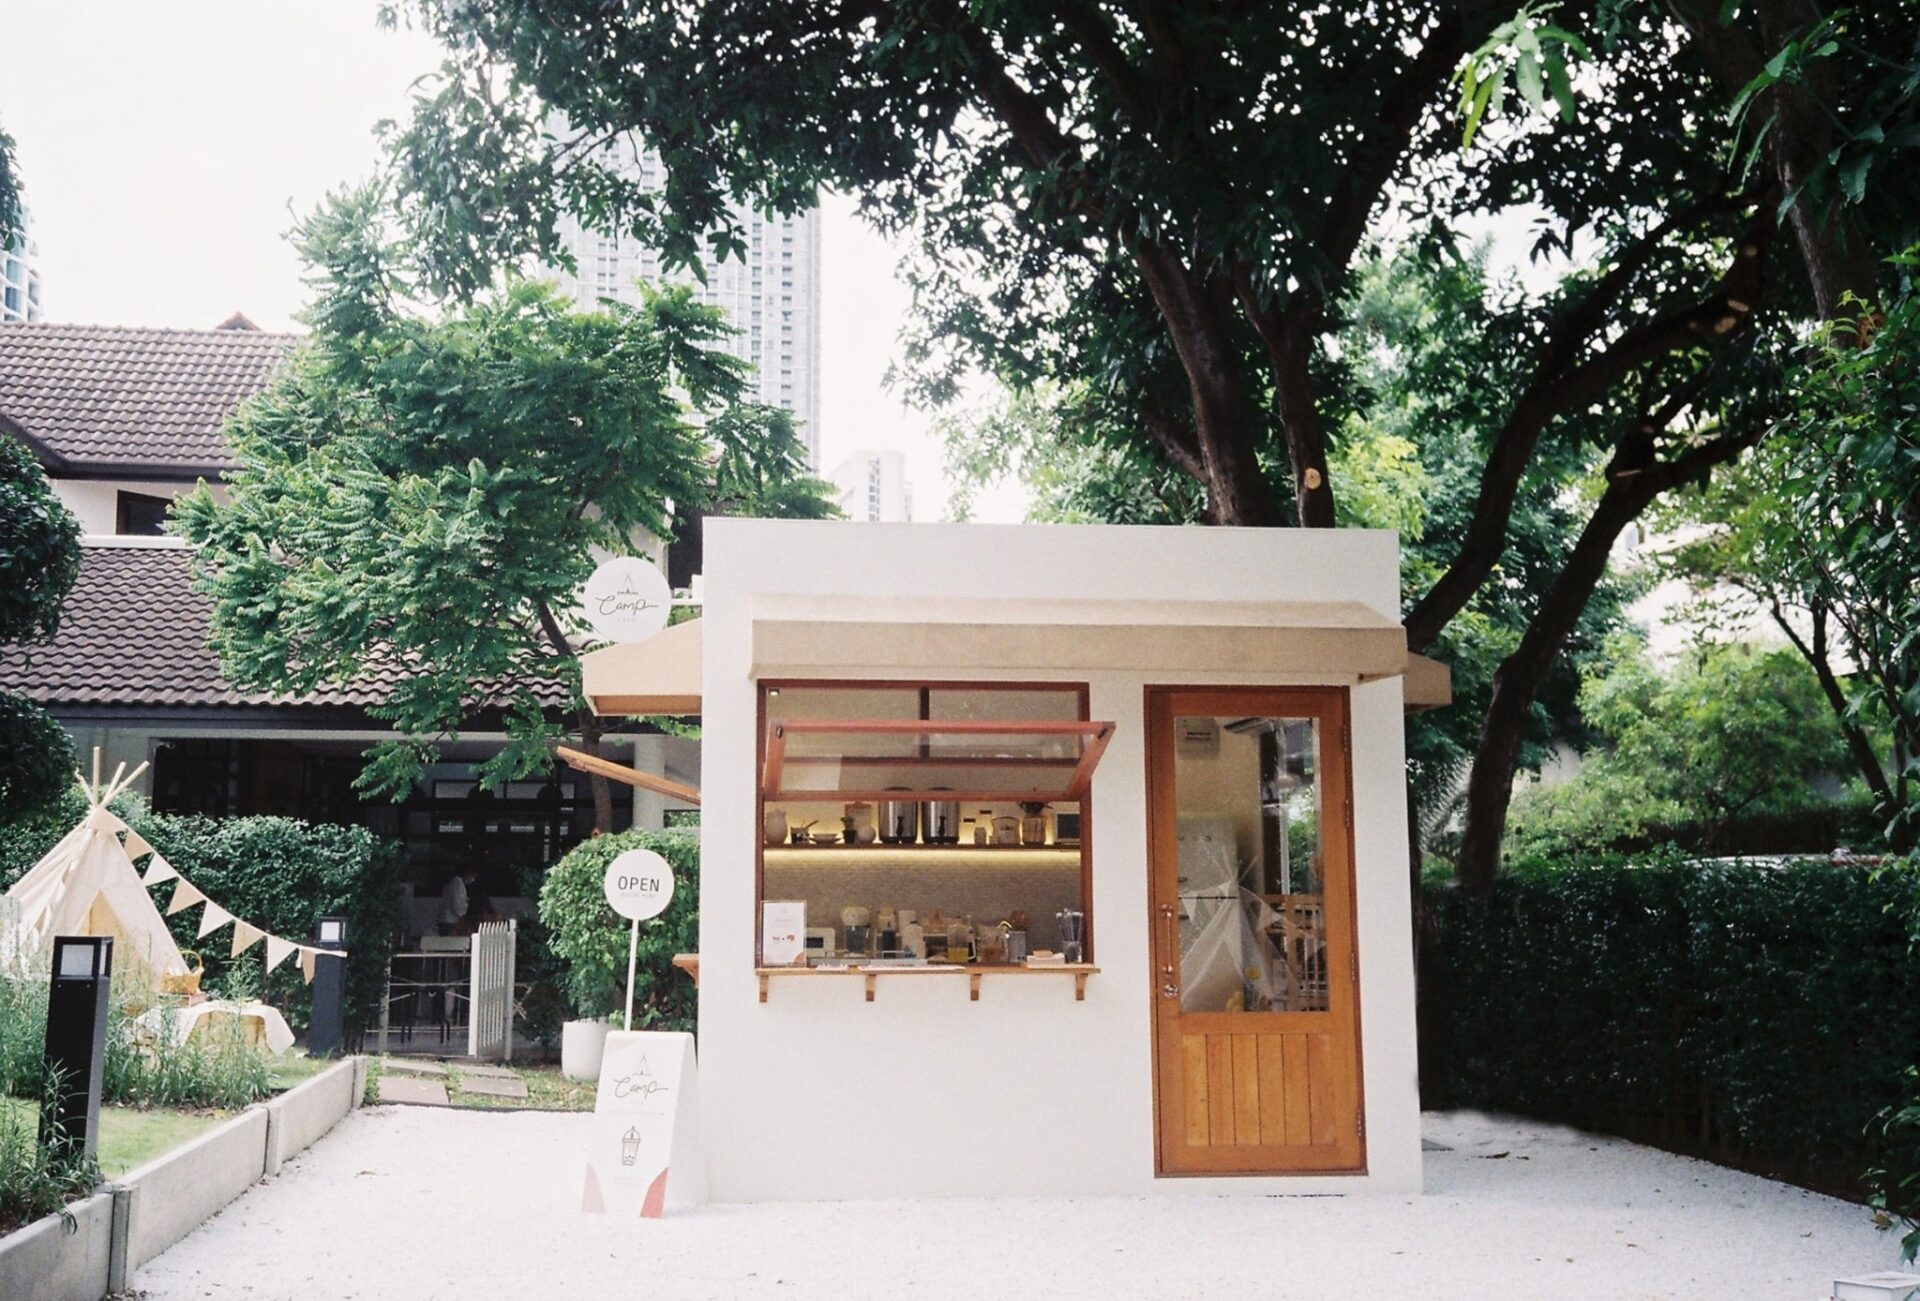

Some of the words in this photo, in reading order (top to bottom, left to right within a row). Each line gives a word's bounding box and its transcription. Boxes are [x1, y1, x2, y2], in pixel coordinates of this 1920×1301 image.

[594, 595, 659, 616] Camp
[617, 875, 660, 893] OPEN
[613, 1076, 669, 1100] Camp
